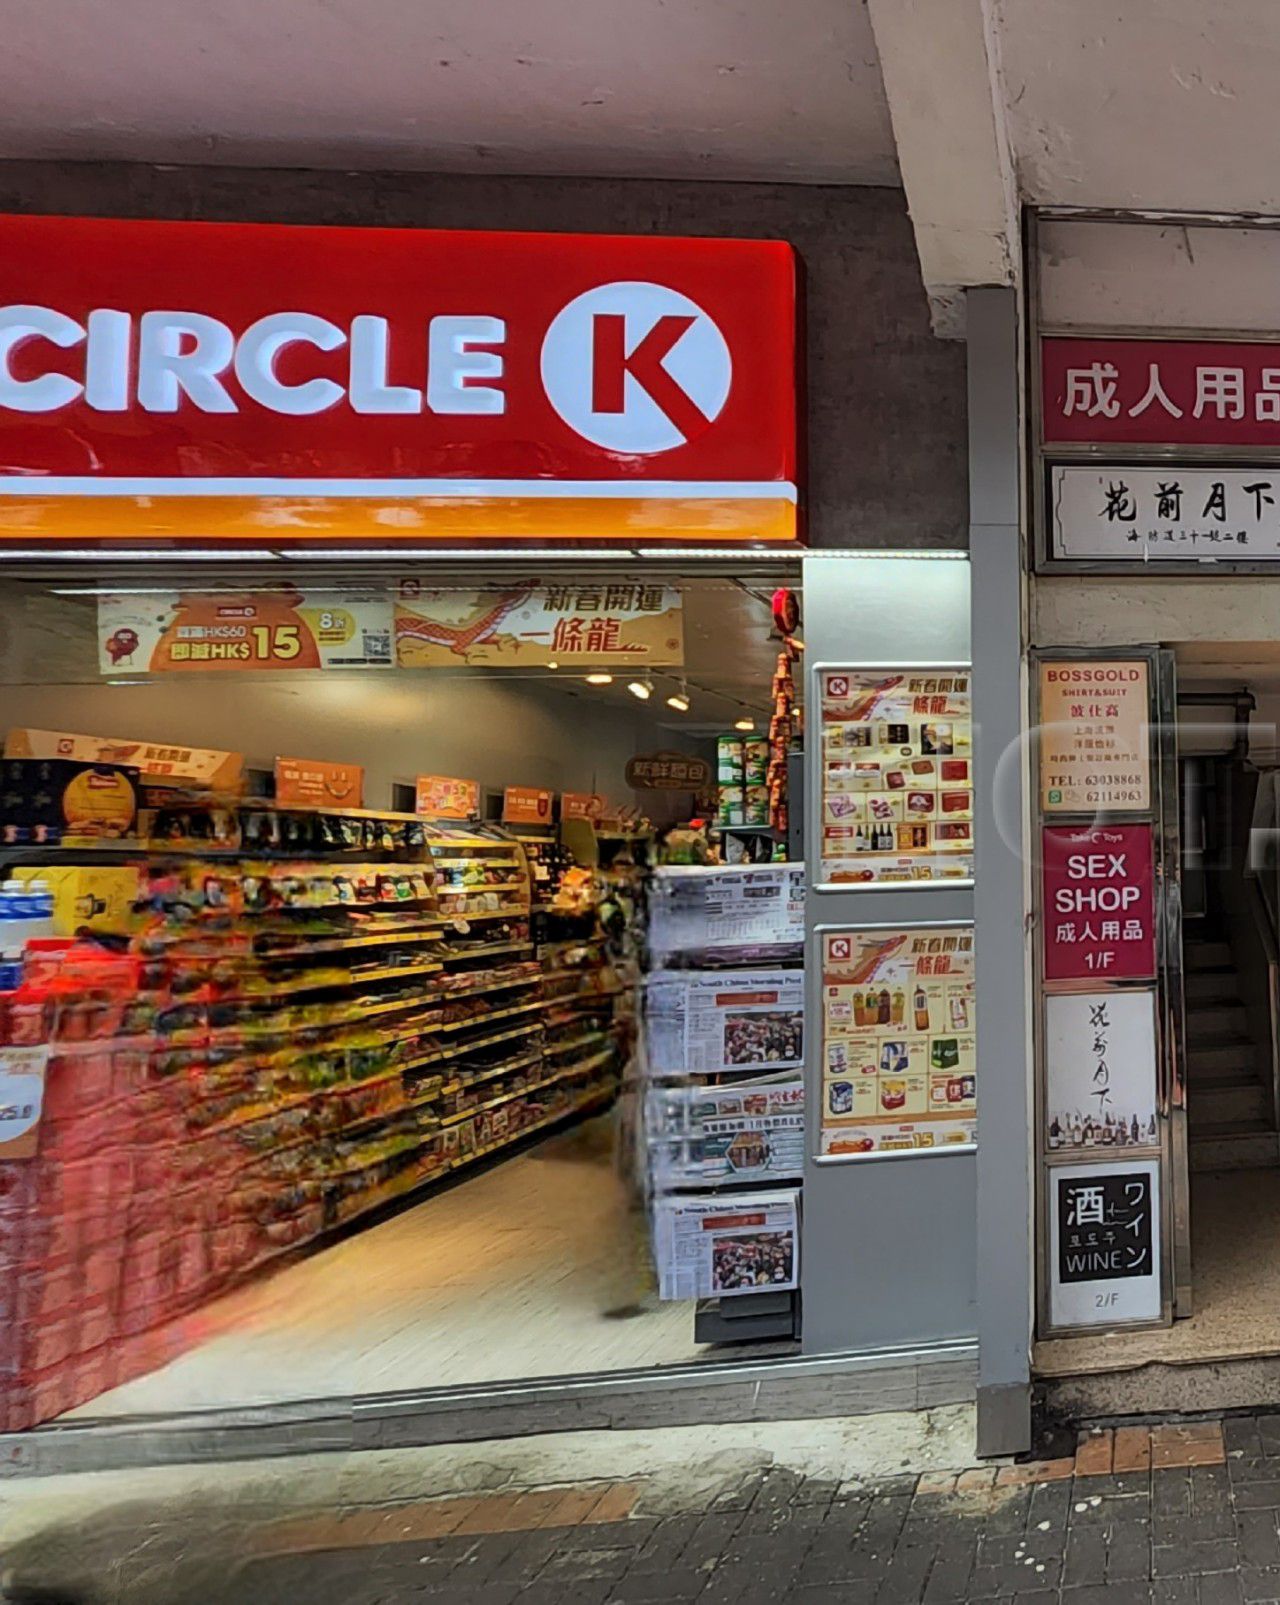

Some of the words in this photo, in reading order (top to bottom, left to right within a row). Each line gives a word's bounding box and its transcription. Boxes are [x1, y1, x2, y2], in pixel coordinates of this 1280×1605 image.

[0, 303, 507, 415] CIRCLE
[1099, 481, 1276, 523] 花前月下
[543, 584, 665, 612] 新春開運
[1047, 670, 1140, 682] BOSSGOLD
[1062, 688, 1127, 697] SHIRT&SUIT
[1049, 775, 1081, 787] TEL:
[1085, 774, 1142, 786] 63038868
[1086, 790, 1142, 802] 62114963
[1067, 854, 1127, 879] SEX
[1055, 887, 1140, 913] SHOP
[1055, 920, 1143, 943] 成人用品
[1085, 952, 1116, 970] 1/F
[1066, 1186, 1105, 1226] 酒
[1124, 1182, 1147, 1269] ワイン
[1066, 1250, 1123, 1273] WINE
[1095, 1292, 1120, 1308] 2/F
